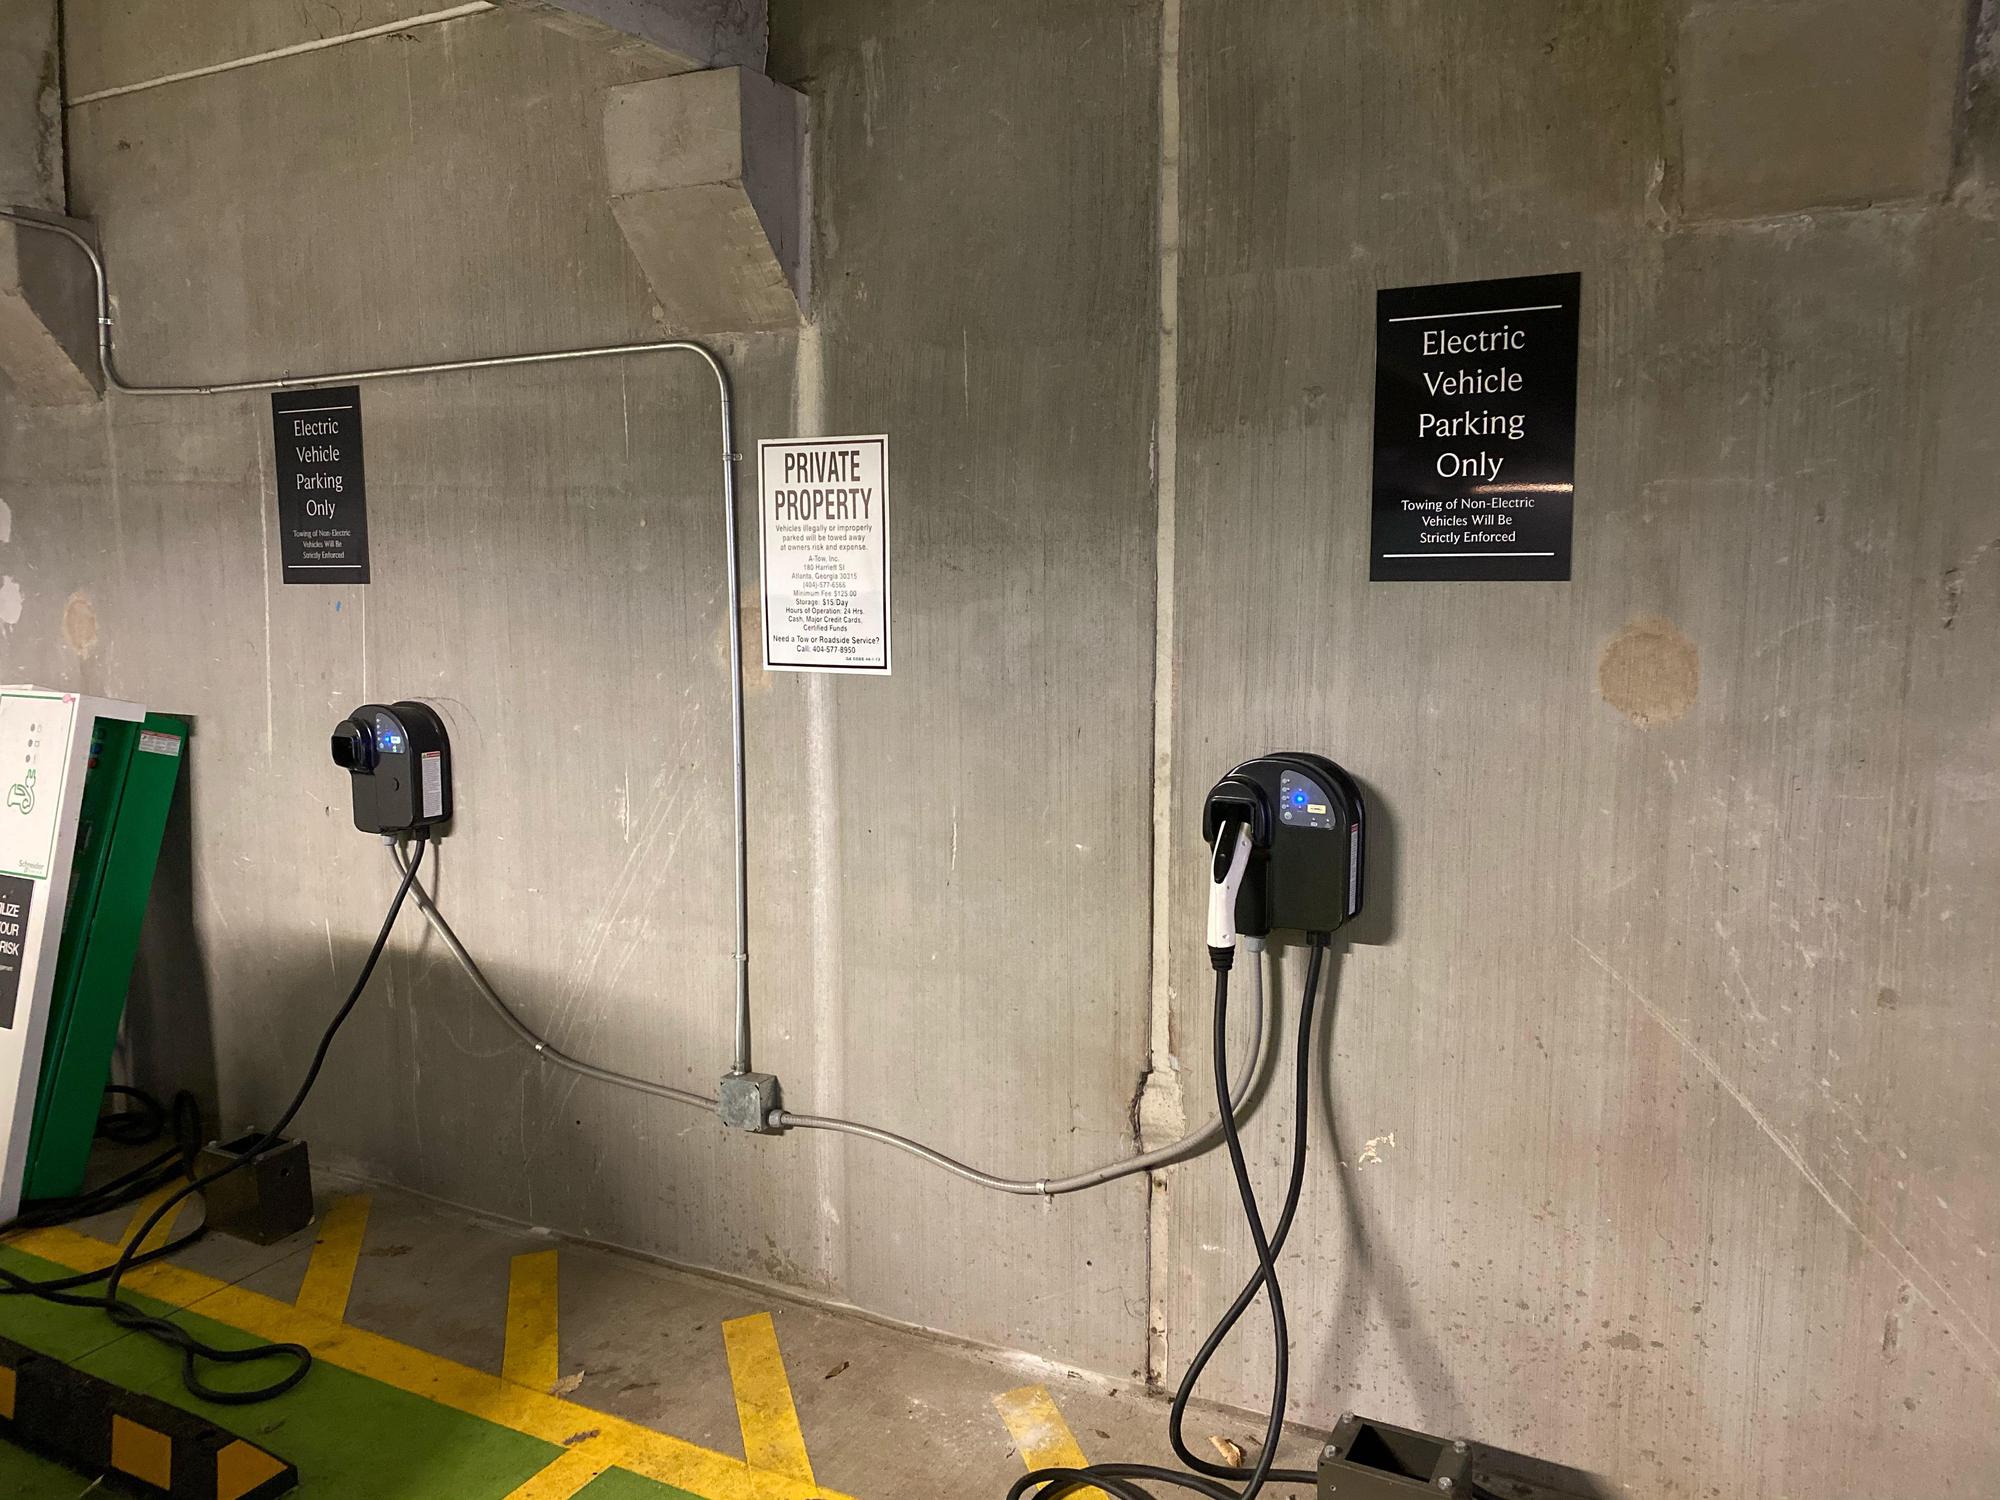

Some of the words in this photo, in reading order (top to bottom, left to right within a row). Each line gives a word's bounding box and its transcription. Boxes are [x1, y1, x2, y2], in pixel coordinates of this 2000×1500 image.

[1423, 325, 1525, 356] Electric
[1423, 367, 1523, 397] Vehicle
[294, 418, 338, 436] Electric
[1418, 410, 1525, 440] Parking
[296, 445, 340, 463] Vehicle
[784, 450, 860, 484] PRIVATE
[1436, 451, 1504, 482] Only
[296, 472, 343, 492] Parking
[306, 499, 336, 519] Only
[775, 488, 872, 520] PROPERTY
[1401, 499, 1442, 512] Towing
[1446, 498, 1458, 509] of
[1461, 497, 1535, 509] Non-Electric
[1422, 515, 1468, 527] Vehicles
[1471, 514, 1495, 526] Will
[1498, 514, 1512, 526] Be
[293, 530, 312, 538] Towing
[319, 529, 351, 537] Non-Electric
[803, 525, 827, 533] illegally
[838, 524, 872, 533] improperly
[324, 540, 334, 548] Will
[336, 540, 342, 548] Be
[782, 534, 804, 543] parked
[1420, 532, 1461, 545] Strictly
[1463, 531, 1516, 543] Enforced
[303, 551, 321, 560] Strictly
[322, 551, 345, 559] Enforced
[815, 573, 838, 581] Georgia
[806, 616, 822, 624] Major
[820, 636, 850, 644] Roadside
[851, 636, 880, 644] Service?
[812, 645, 856, 654] 404-577-8950
[0, 921, 19, 936] OUR
